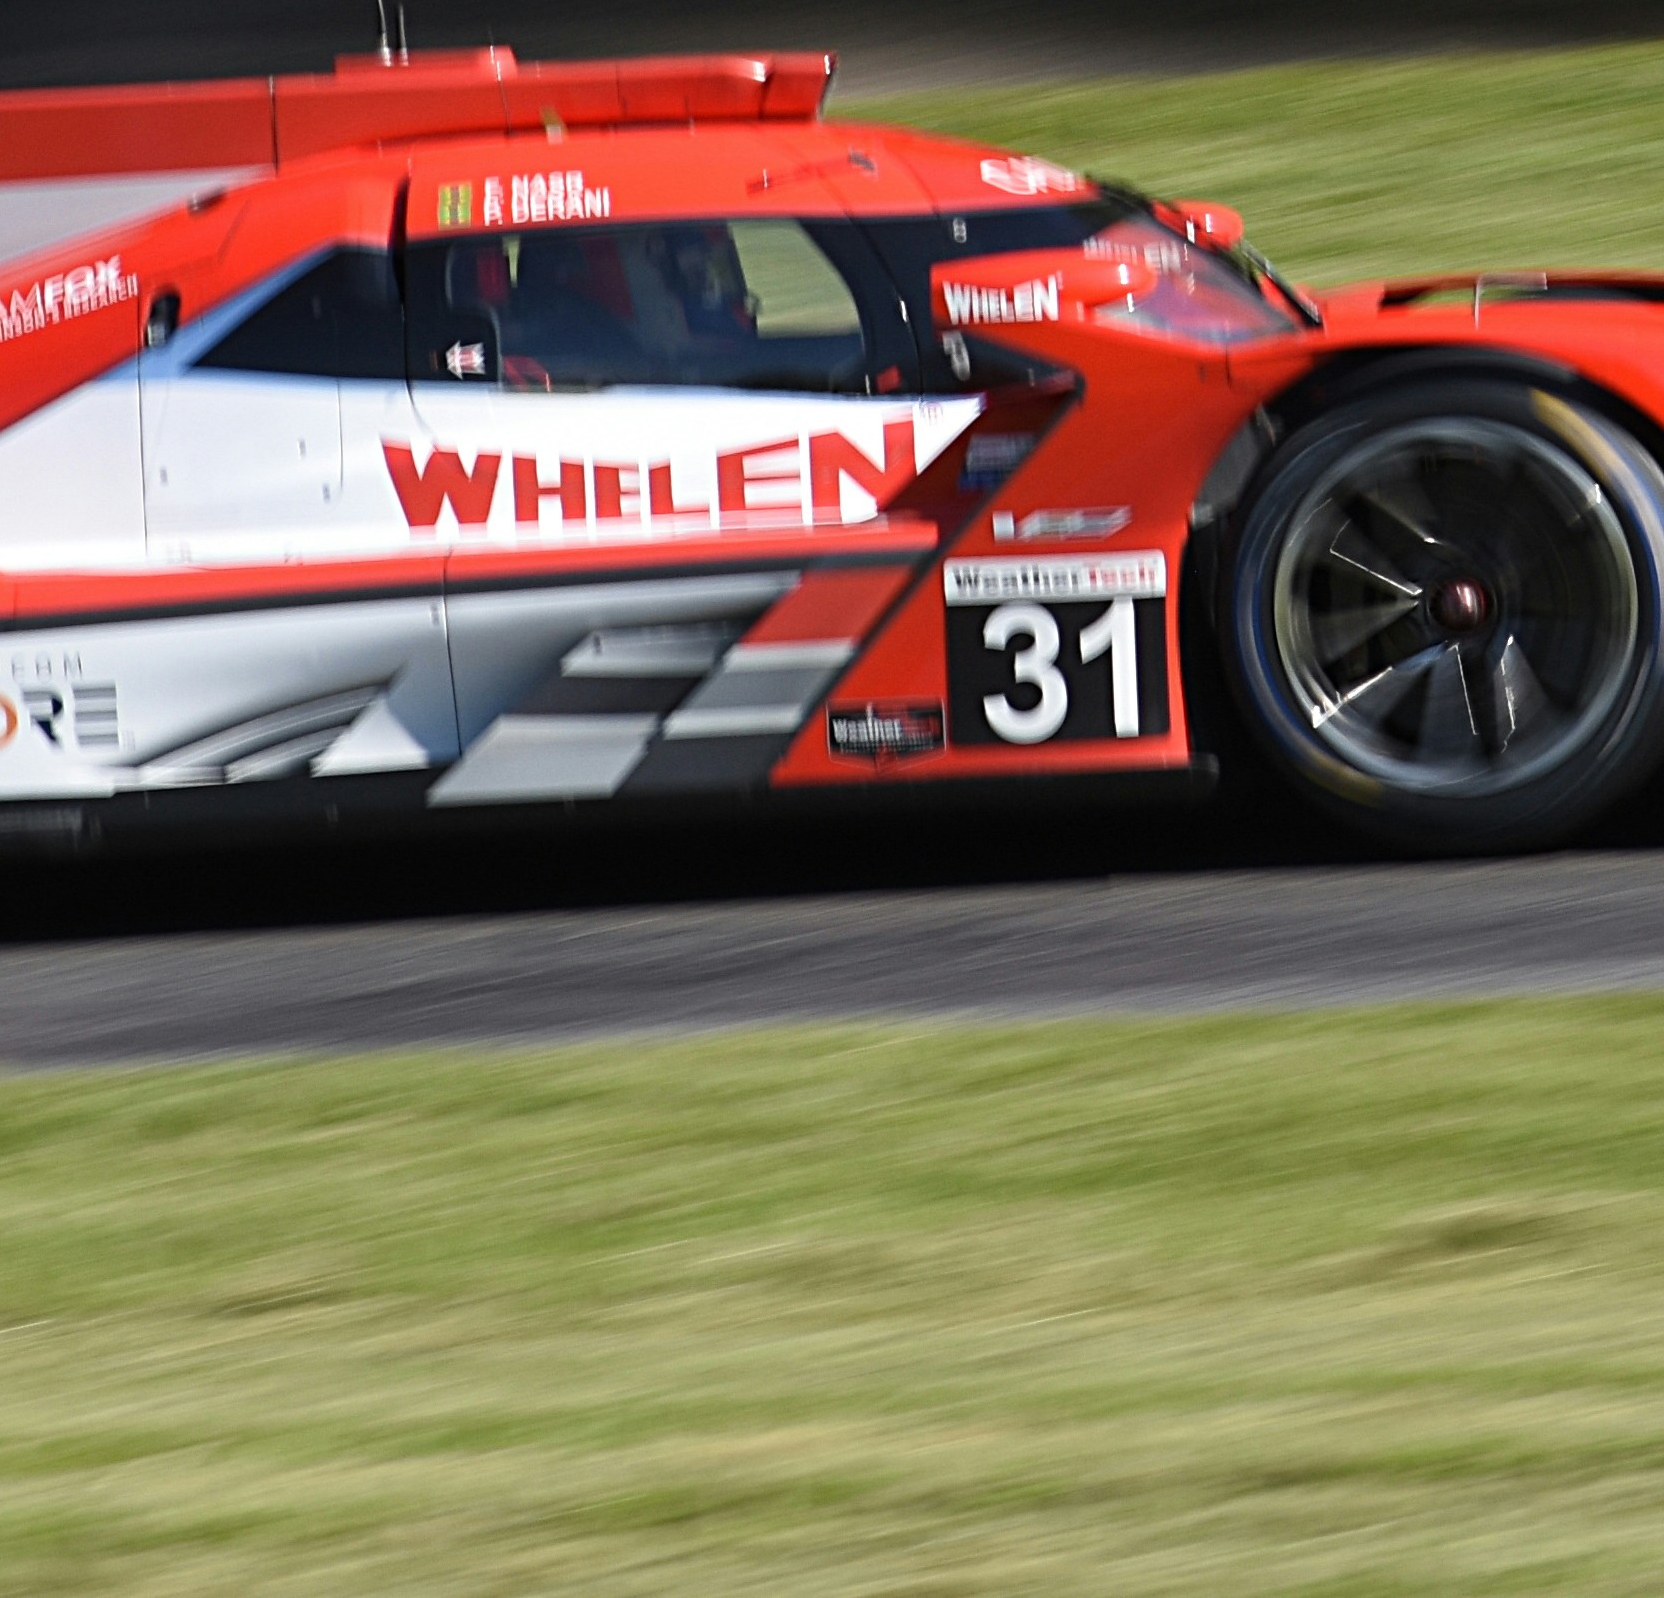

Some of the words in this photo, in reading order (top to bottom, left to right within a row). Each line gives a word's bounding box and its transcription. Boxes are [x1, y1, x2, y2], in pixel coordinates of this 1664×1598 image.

[512, 187, 610, 223] DERANI
[943, 273, 1059, 325] WHELEN
[383, 408, 921, 530] WHELEN
[952, 562, 1156, 599] WeatherTech
[983, 597, 1140, 745] 31
